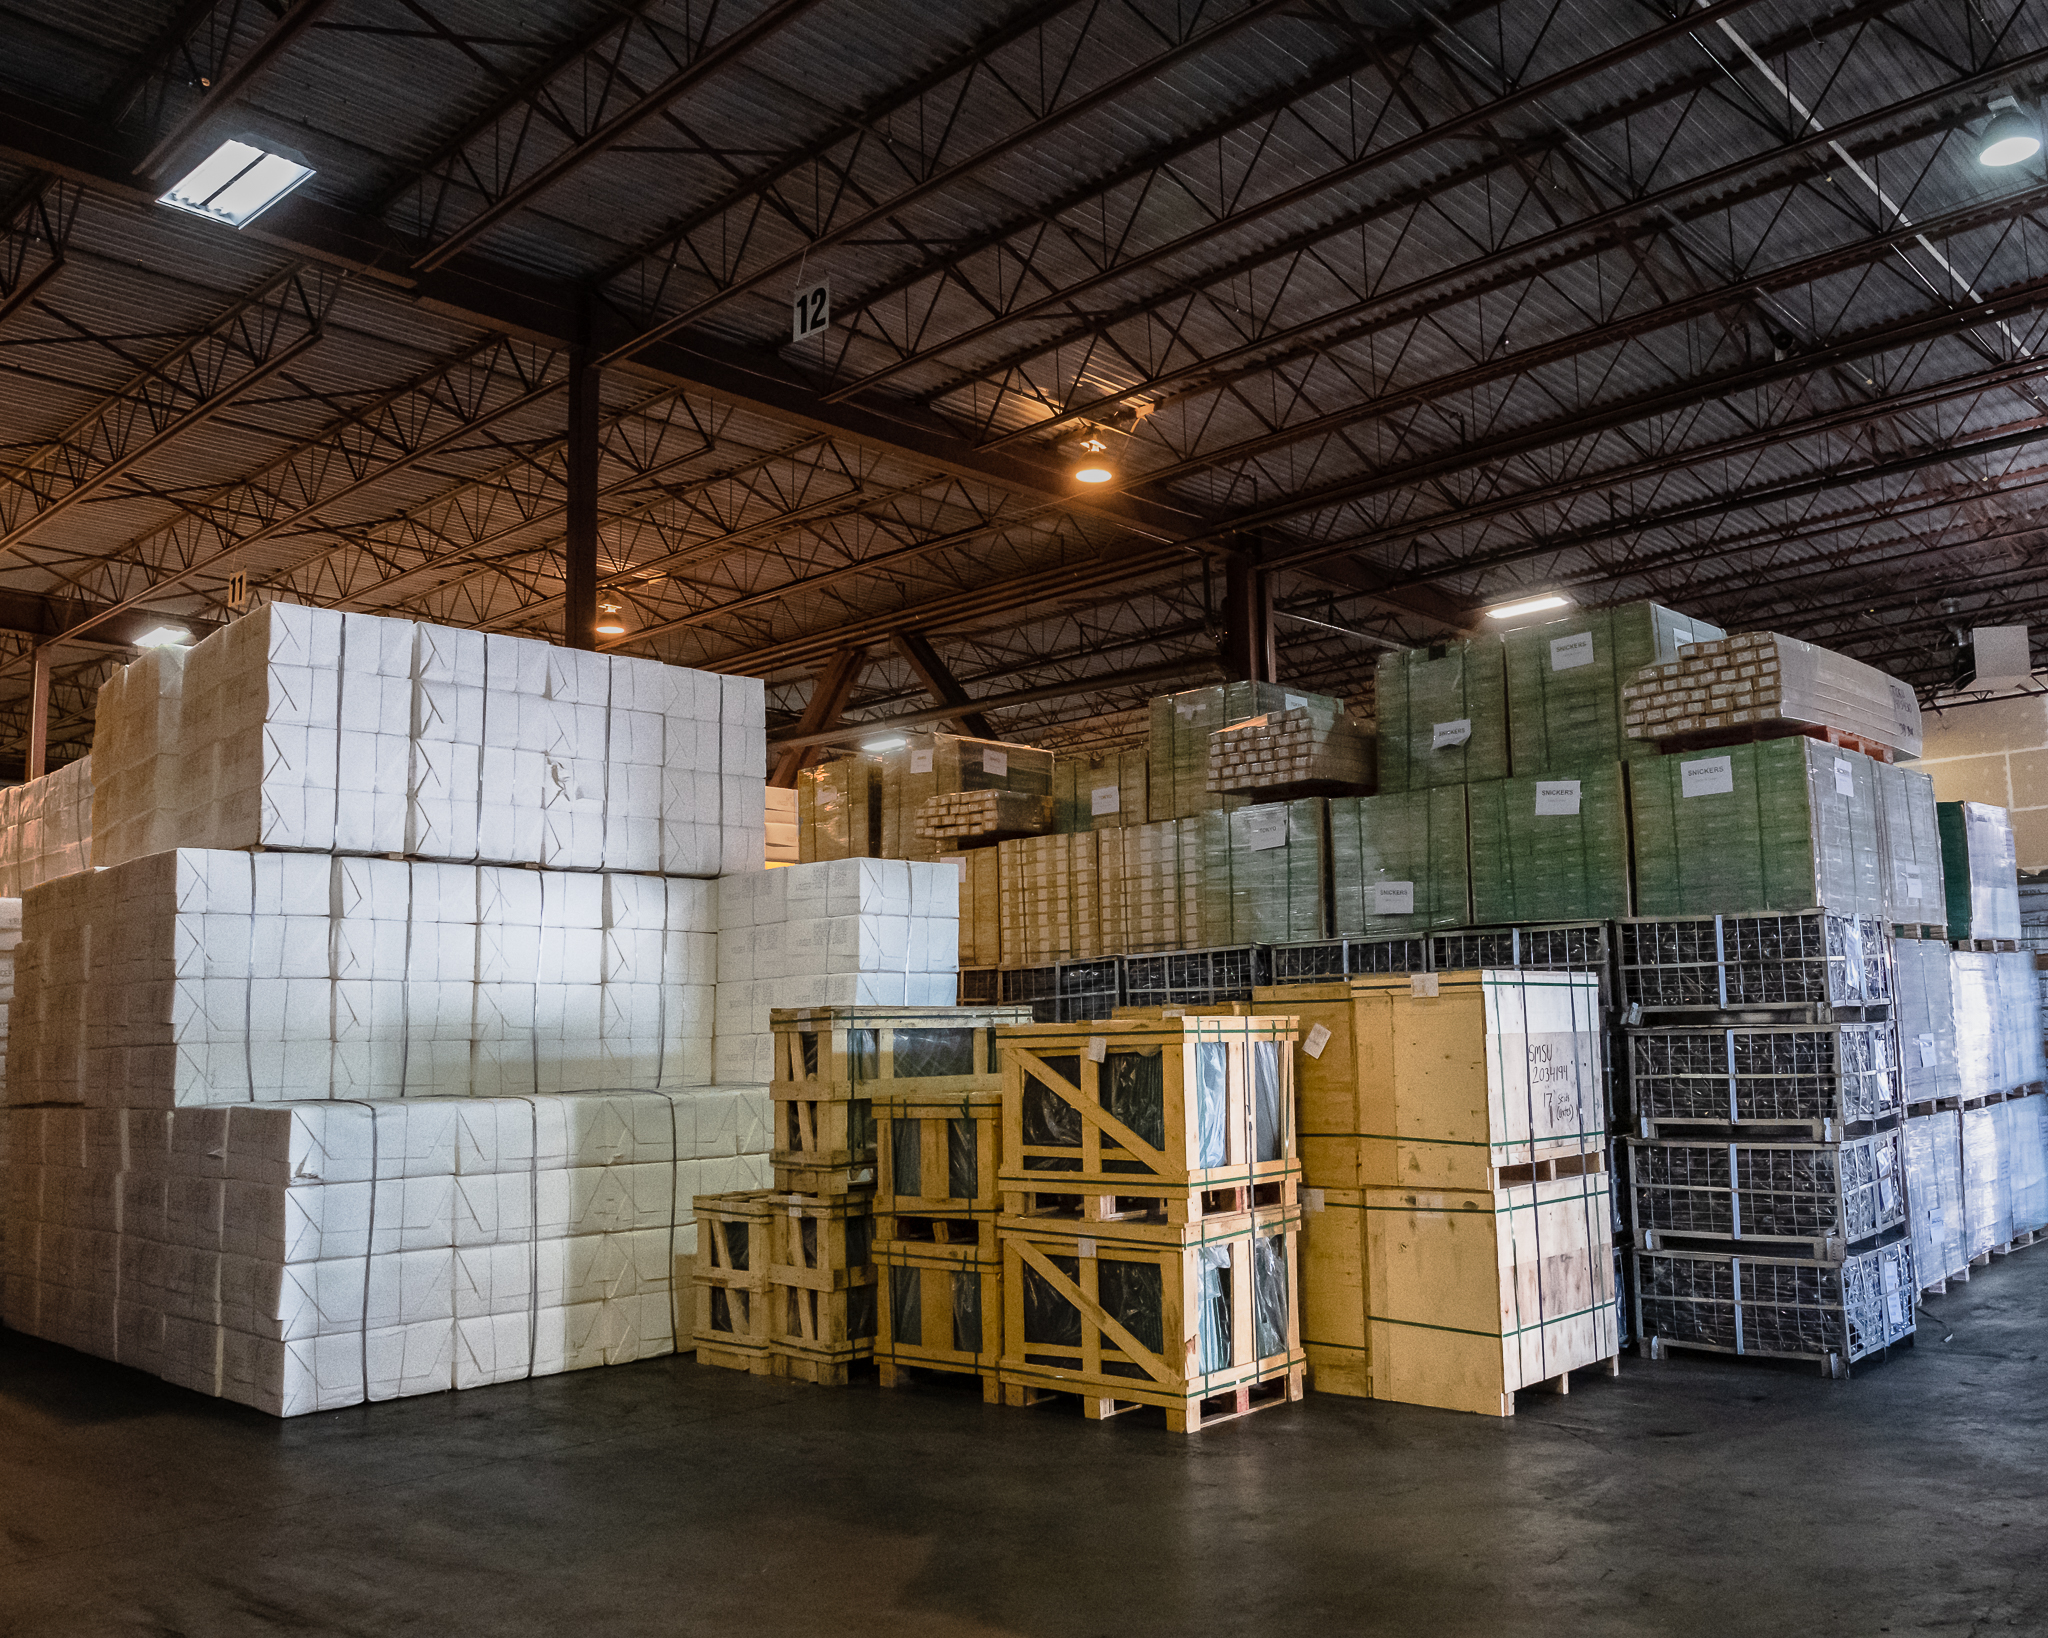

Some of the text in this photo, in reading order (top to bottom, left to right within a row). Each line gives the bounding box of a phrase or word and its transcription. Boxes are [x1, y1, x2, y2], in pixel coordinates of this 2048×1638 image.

[797, 288, 826, 334] 12
[231, 575, 243, 603] 11
[1556, 640, 1587, 653] SNICKERS
[1439, 727, 1466, 737] SNICKERS
[1688, 766, 1724, 777] SNICKERS
[1259, 825, 1277, 834] TOKYO
[1532, 1065, 1568, 1084] 2034194
